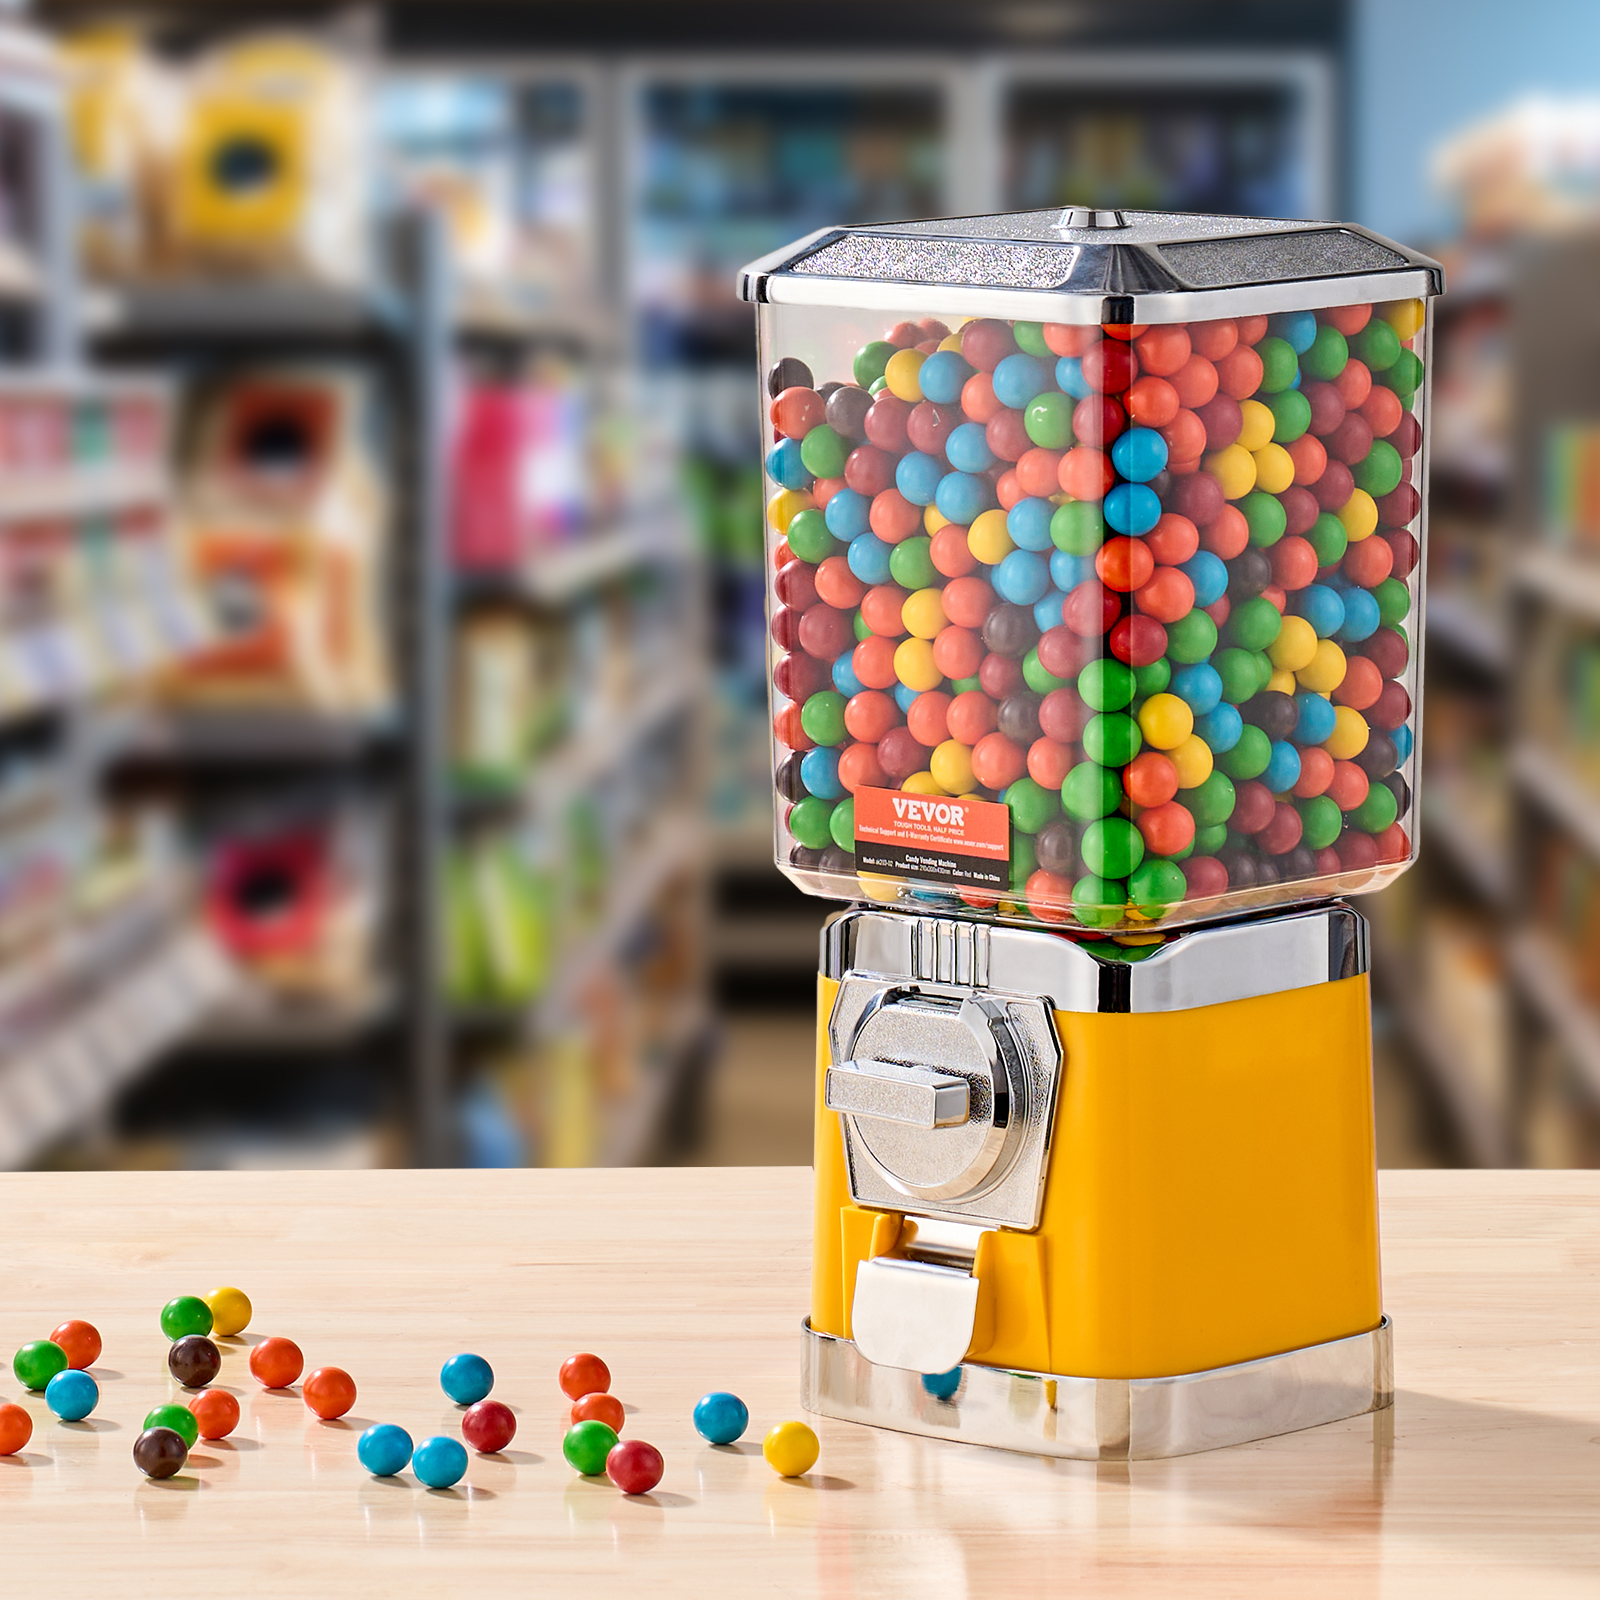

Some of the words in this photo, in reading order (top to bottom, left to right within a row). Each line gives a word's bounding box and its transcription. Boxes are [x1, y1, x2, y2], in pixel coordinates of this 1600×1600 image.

[892, 797, 964, 826] VEVOR
[859, 824, 879, 834] Technical
[879, 827, 897, 837] Support
[897, 830, 905, 838] and
[930, 834, 953, 845] Certificate
[894, 820, 913, 829] TOUGH
[933, 825, 947, 834] HALF
[948, 828, 964, 836] PRICE
[905, 854, 919, 864] Candy
[920, 856, 938, 867] Vending
[938, 859, 957, 869] Machine
